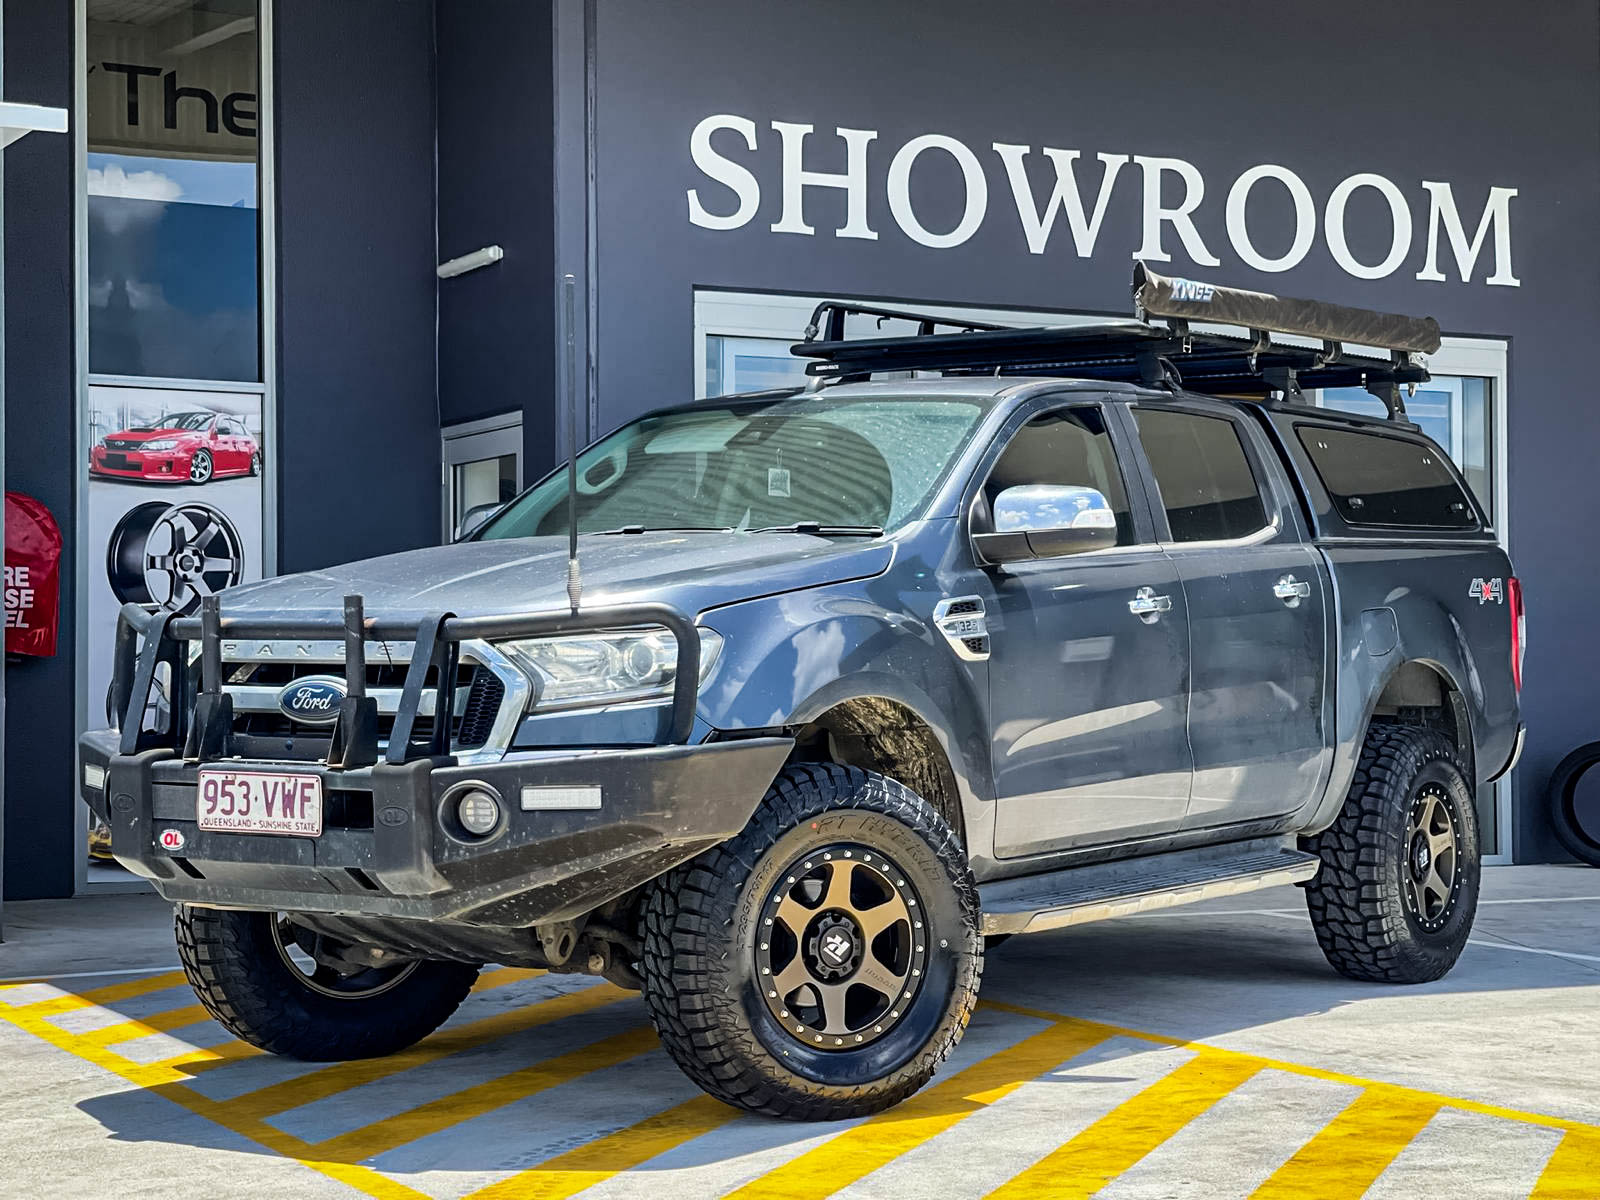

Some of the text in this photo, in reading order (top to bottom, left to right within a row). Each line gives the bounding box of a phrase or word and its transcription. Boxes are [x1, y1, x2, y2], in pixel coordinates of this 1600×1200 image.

[686, 114, 1521, 287] SHOWROOM
[292, 686, 334, 711] Ford
[203, 817, 316, 832] QUEENSLAND SUNSHINE STATE
[163, 832, 181, 846] OL
